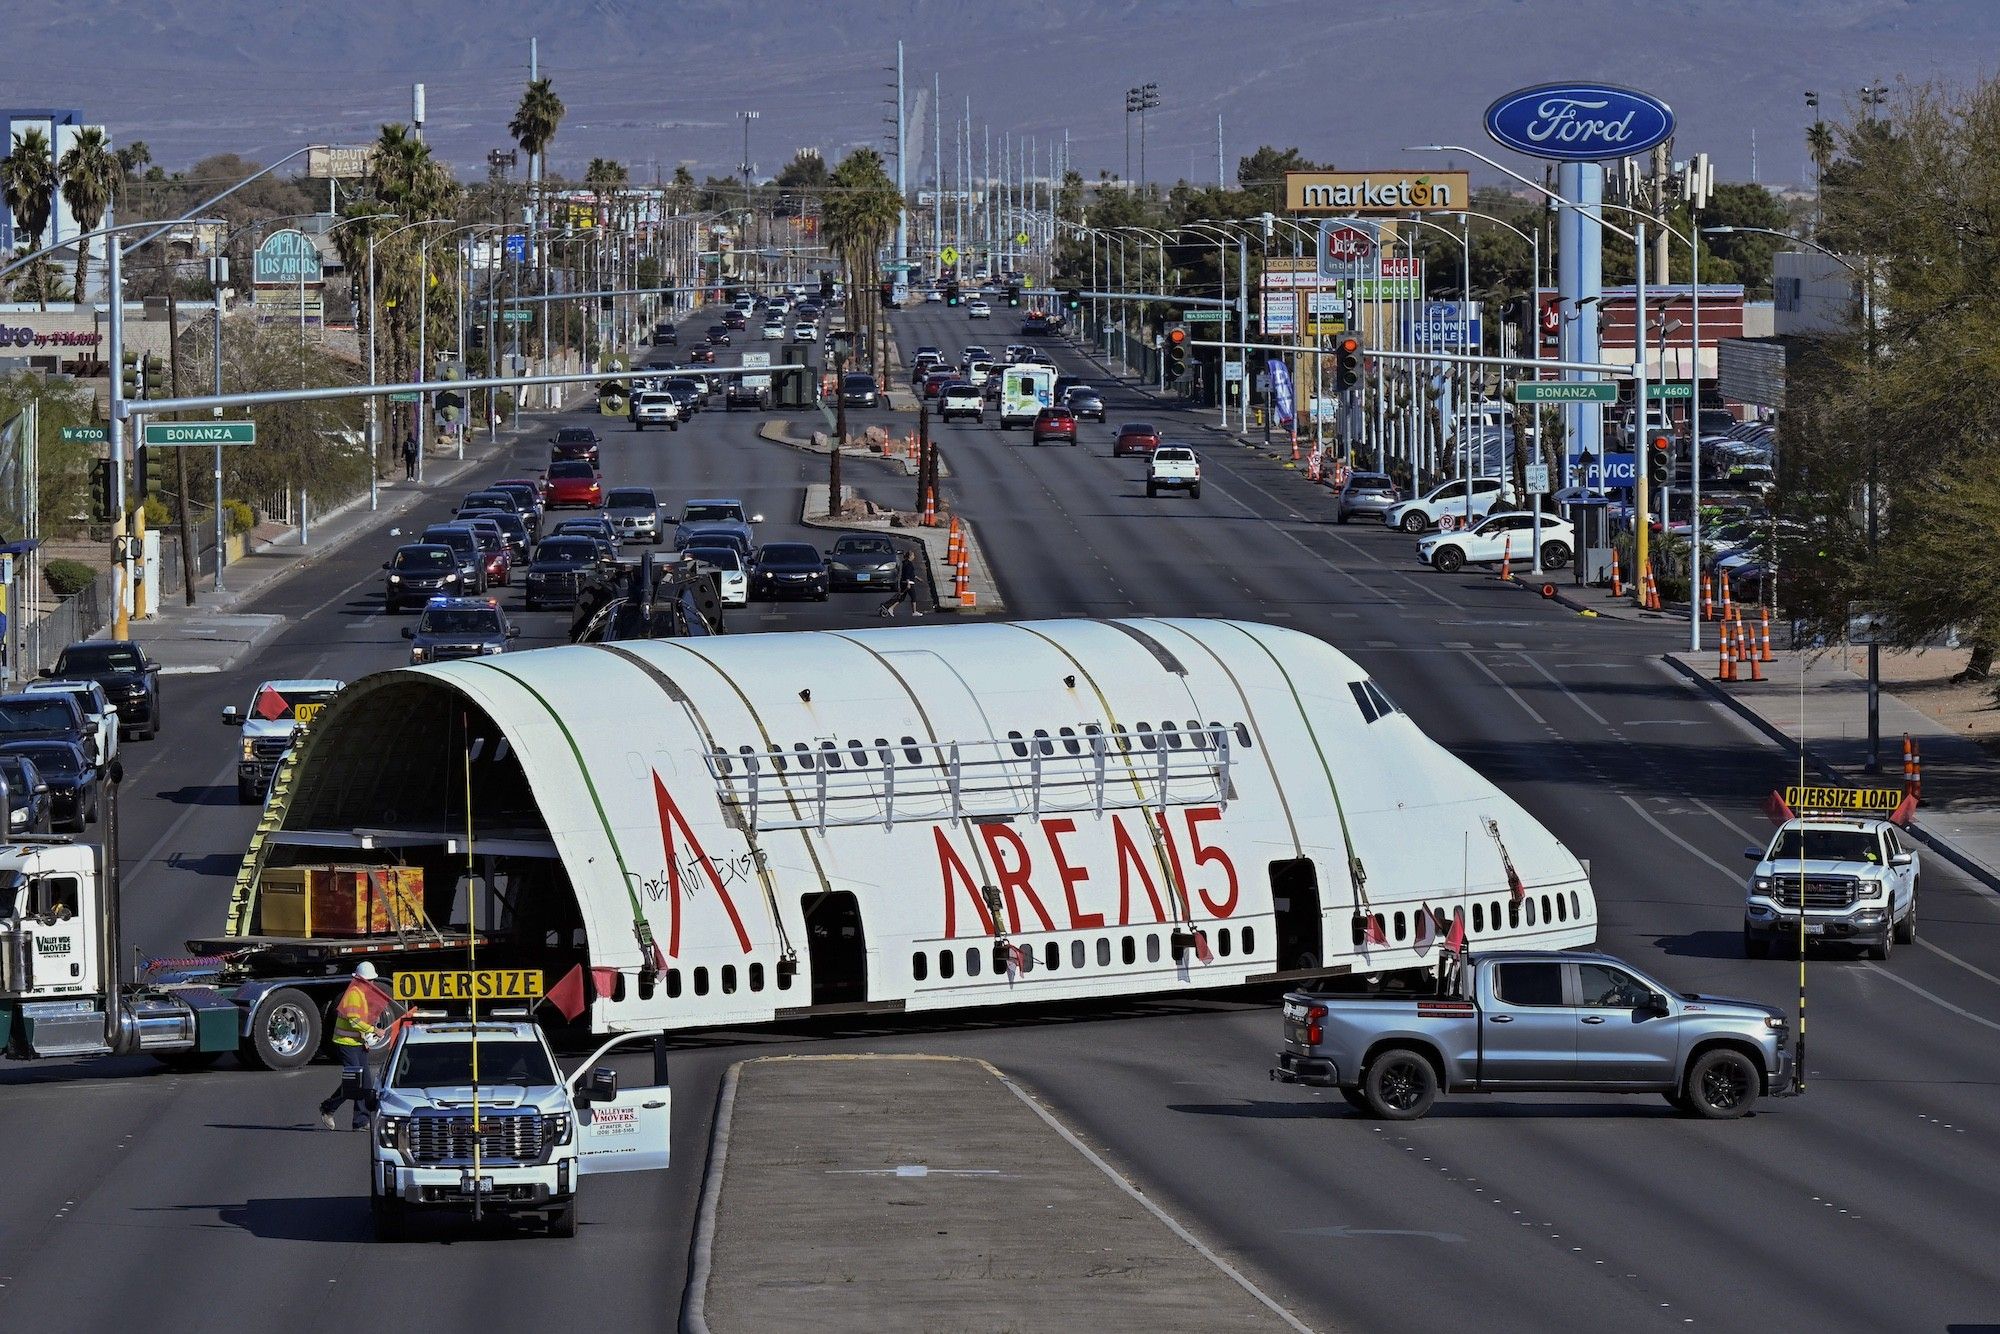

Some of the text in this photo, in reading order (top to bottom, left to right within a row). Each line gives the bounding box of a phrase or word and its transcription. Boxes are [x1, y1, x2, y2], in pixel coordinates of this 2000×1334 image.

[1527, 98, 1636, 142] Ford
[330, 149, 370, 160] BEAUTY
[265, 234, 311, 256] PLAZA
[261, 258, 317, 275] LOS ARCOS
[1374, 282, 1416, 297] poduce
[1536, 387, 1597, 398] BONANZA
[1652, 386, 1690, 396] W 4600
[63, 427, 103, 439] W 4700
[166, 429, 233, 440] BONANZA
[1569, 463, 1636, 479] SRVICE
[1789, 787, 1899, 808] OVERSIZE LOAD
[36, 936, 57, 952] VALLEY
[43, 943, 71, 952] MOVERS
[400, 972, 538, 997] OVERSIZE
[592, 1108, 620, 1123] VALLEY
